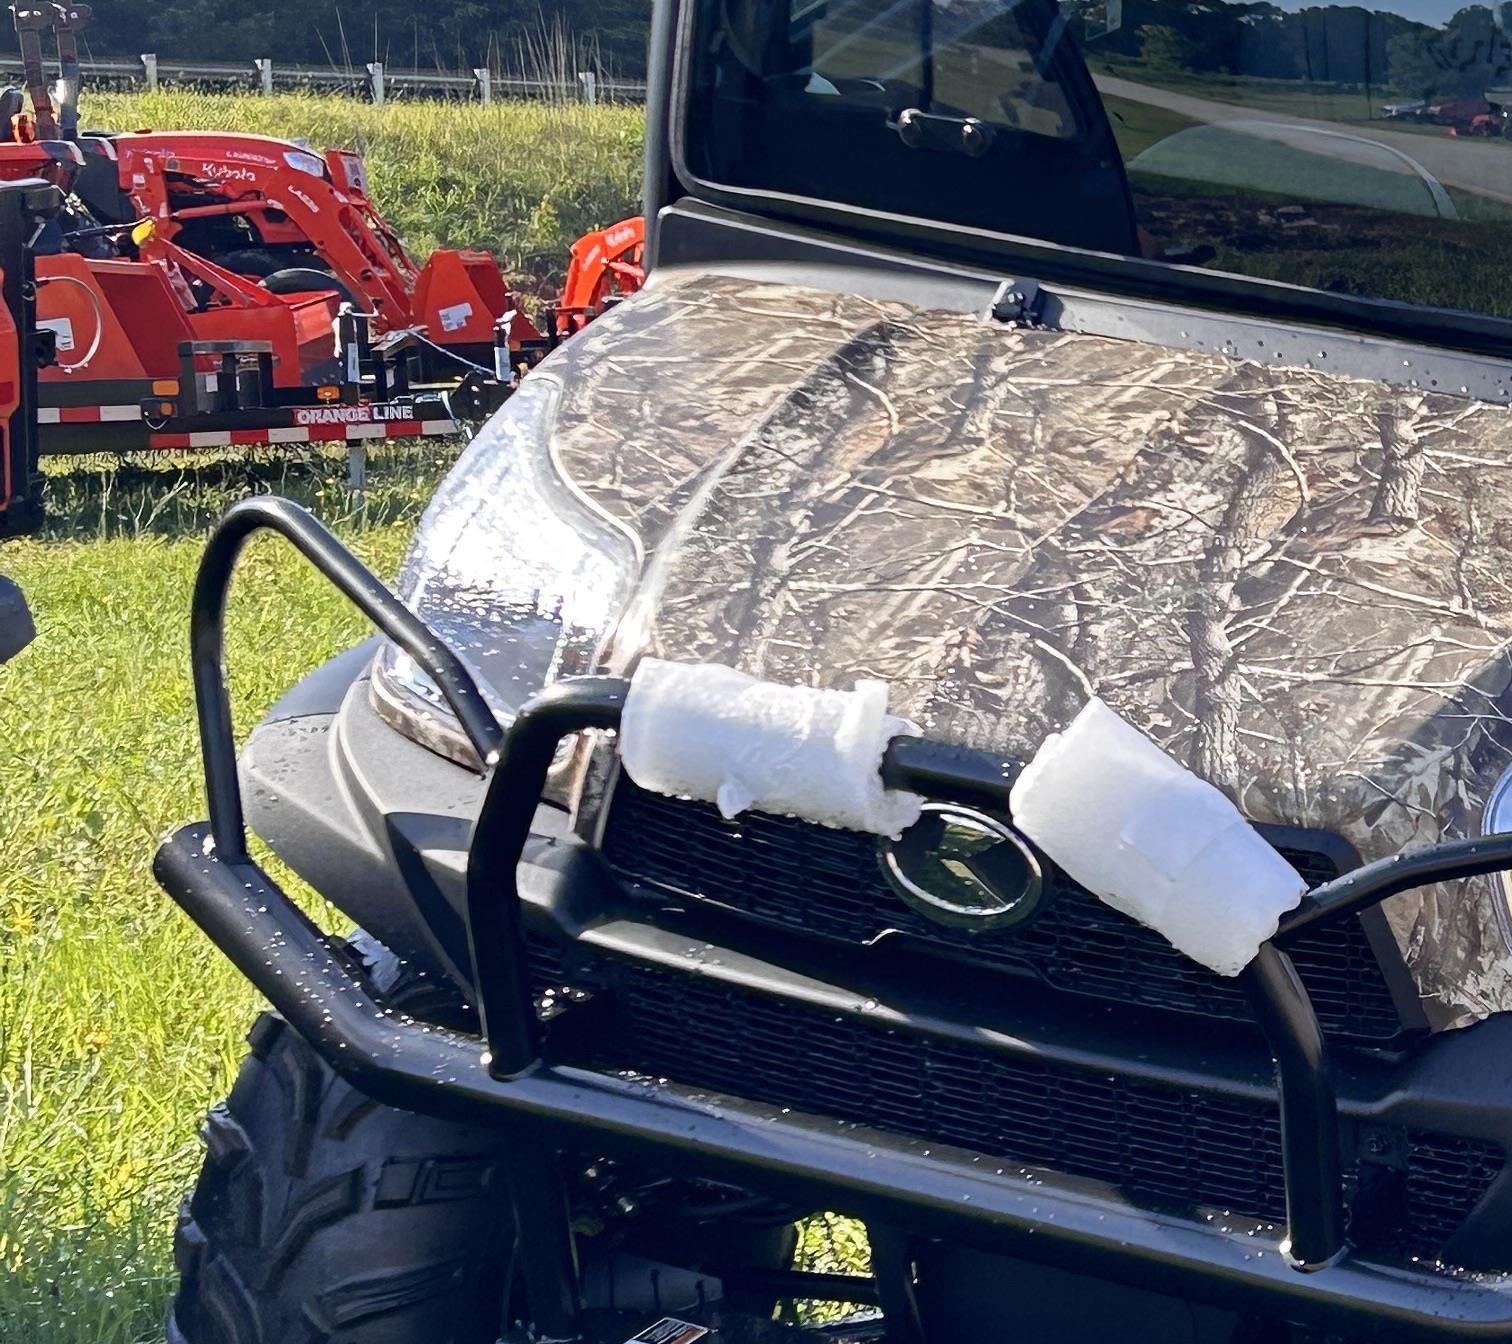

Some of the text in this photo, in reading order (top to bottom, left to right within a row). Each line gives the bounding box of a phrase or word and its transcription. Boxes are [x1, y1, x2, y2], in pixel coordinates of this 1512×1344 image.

[202, 161, 257, 182] Kubota
[298, 406, 414, 425] ORANGE LINE
